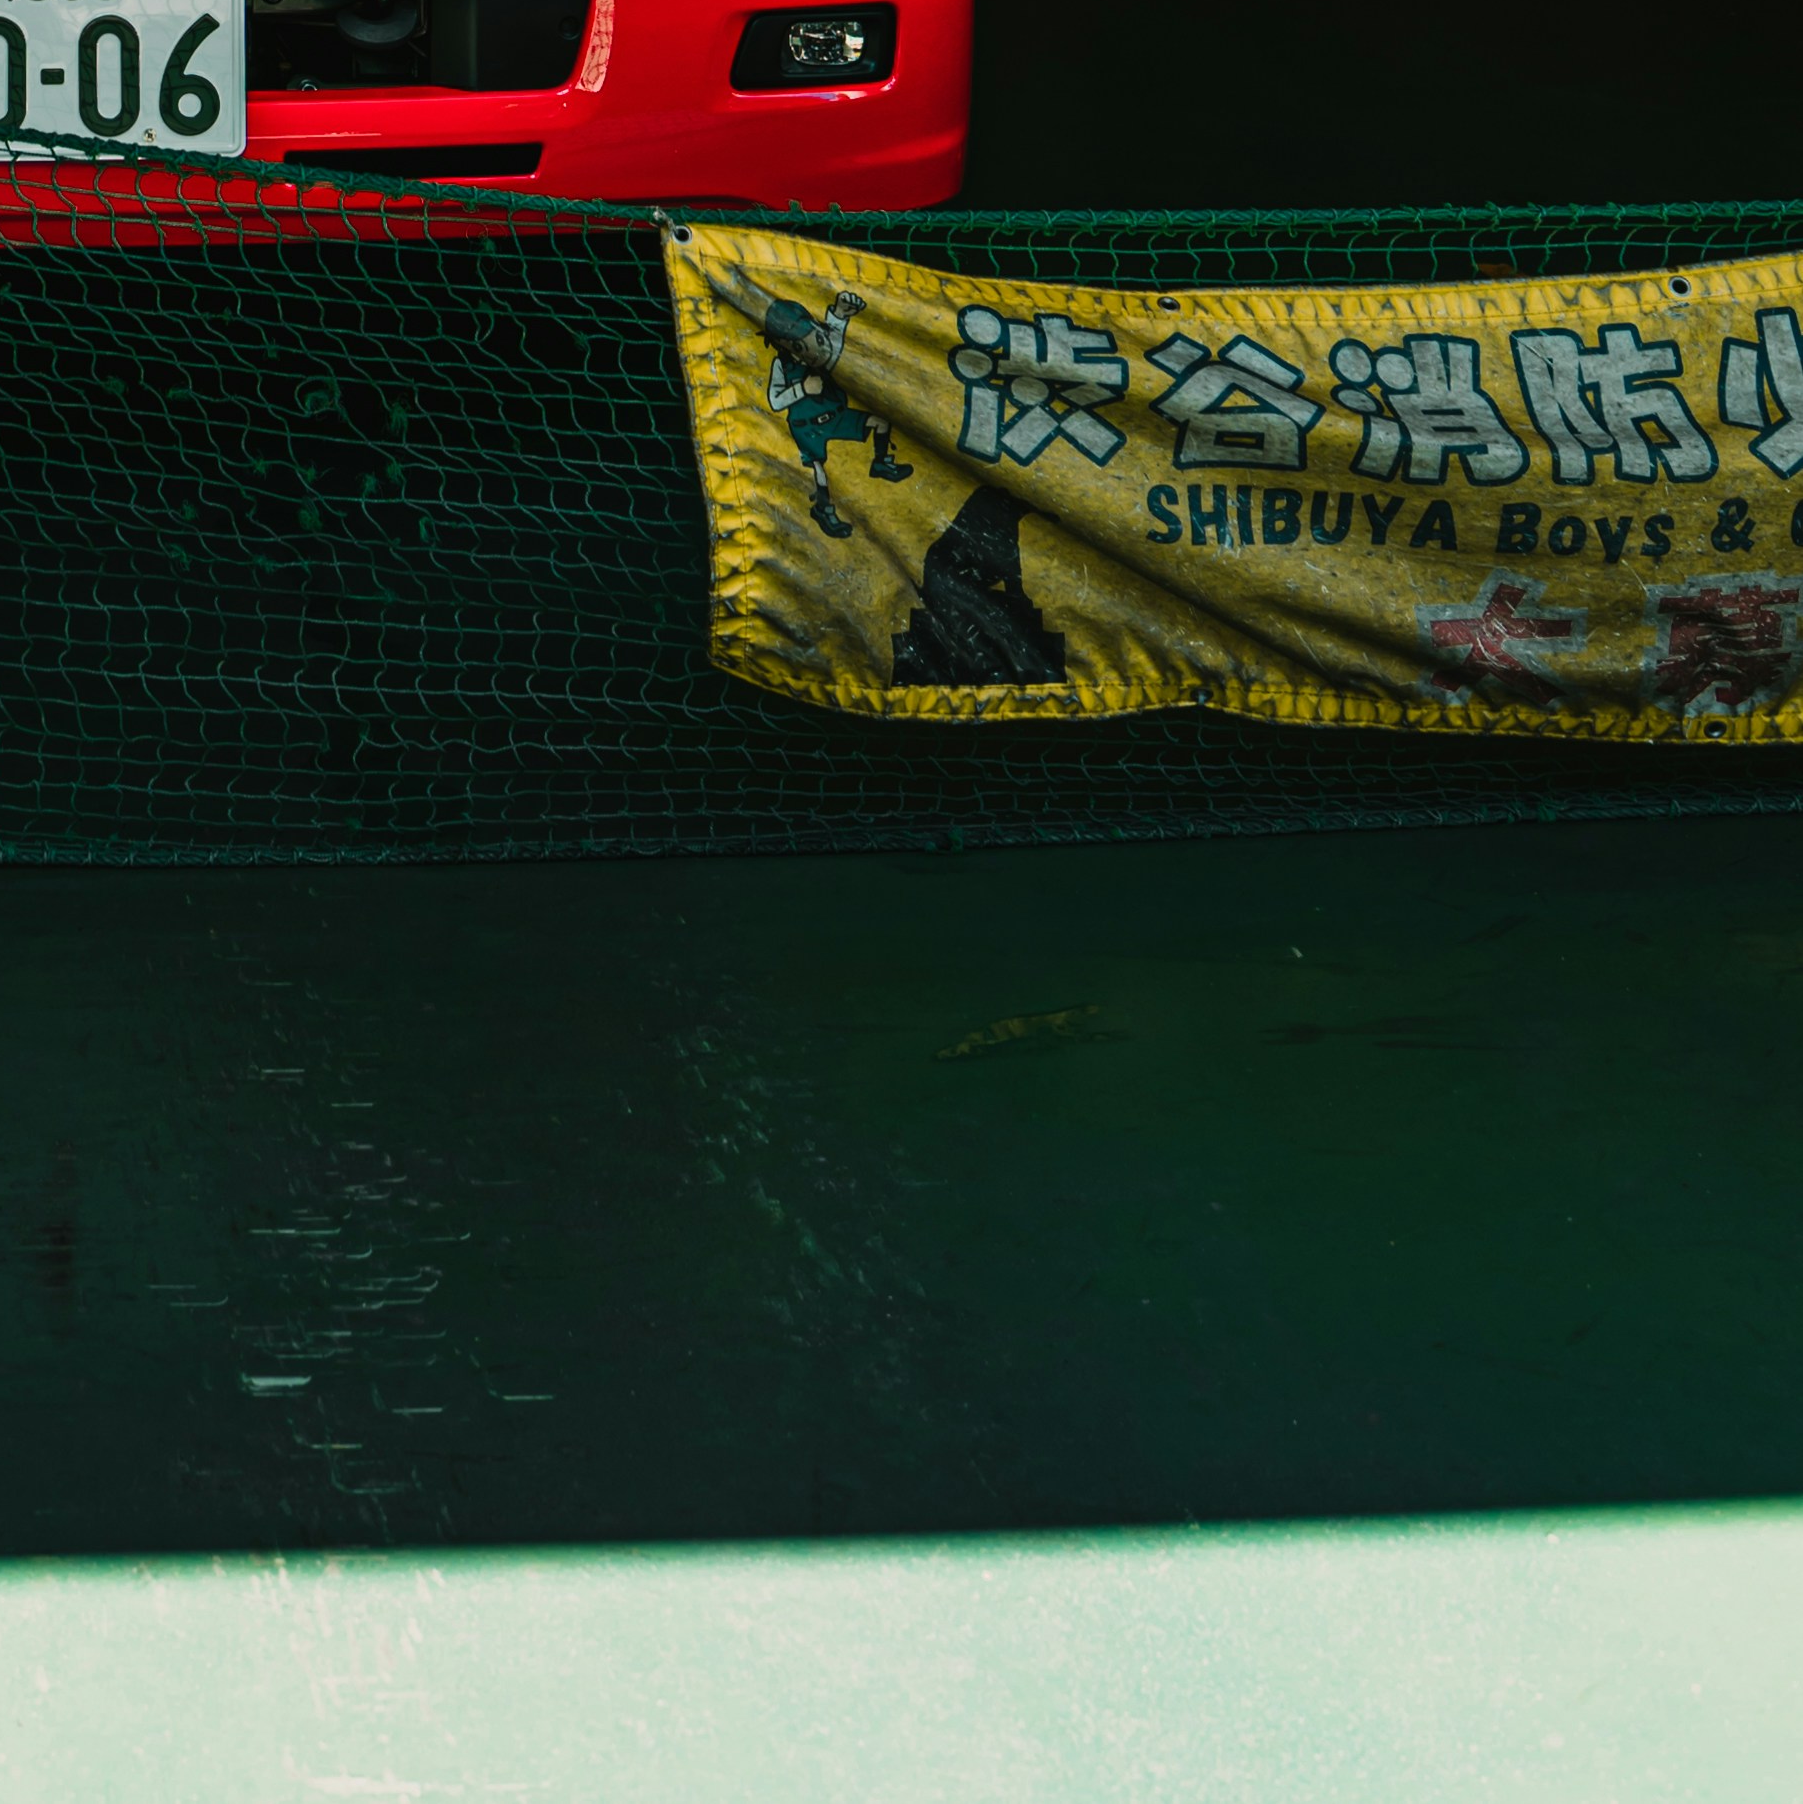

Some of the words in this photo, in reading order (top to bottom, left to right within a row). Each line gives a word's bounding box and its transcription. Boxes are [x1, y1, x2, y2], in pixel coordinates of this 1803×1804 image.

[1146, 483, 1459, 551] SHIBUYA
[1496, 501, 1675, 564] Boys
[1710, 496, 1756, 553] &
